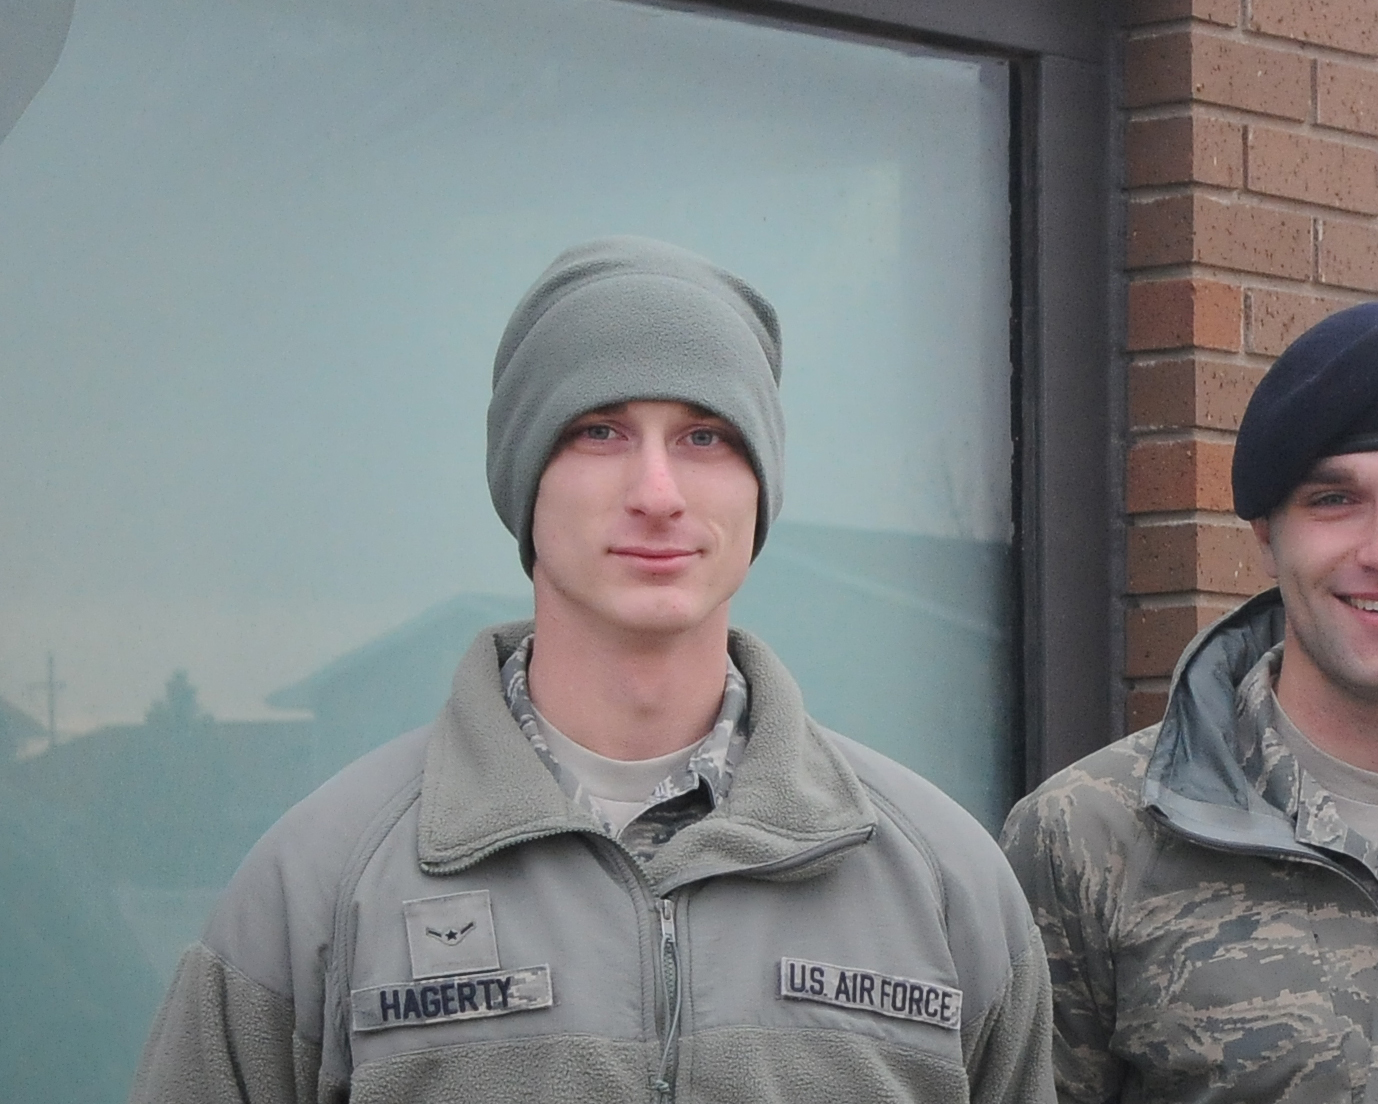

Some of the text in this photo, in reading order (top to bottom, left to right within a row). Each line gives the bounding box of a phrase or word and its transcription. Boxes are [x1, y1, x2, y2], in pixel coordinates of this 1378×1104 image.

[380, 976, 512, 1021] HAGERTY
[789, 962, 953, 1022] U.S. AIR FORCE
